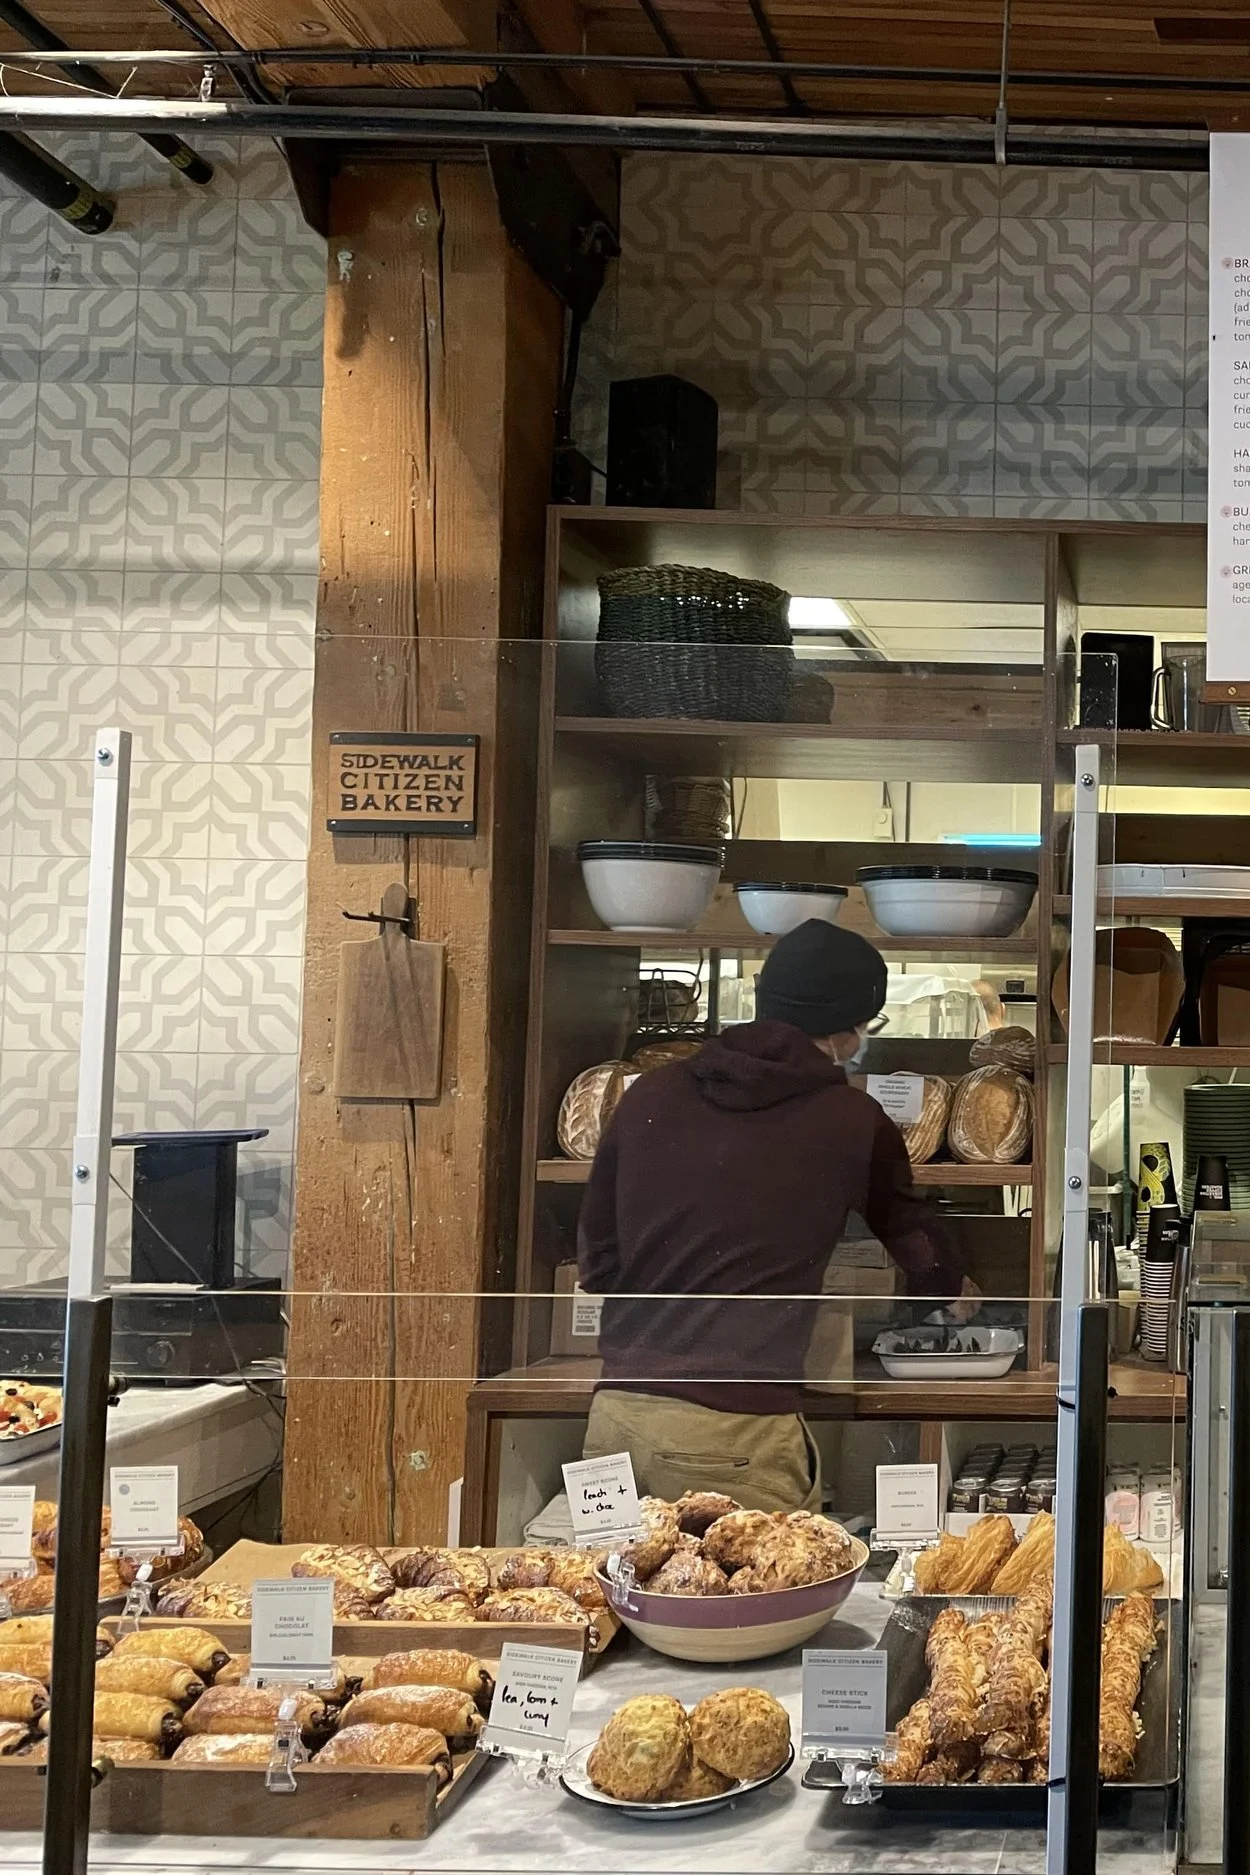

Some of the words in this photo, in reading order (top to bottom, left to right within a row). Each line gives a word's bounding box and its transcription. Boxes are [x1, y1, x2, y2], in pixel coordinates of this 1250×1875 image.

[341, 753, 465, 770] SIDEWALK
[340, 772, 464, 791] CITIZEN
[341, 794, 464, 813] BAKERY
